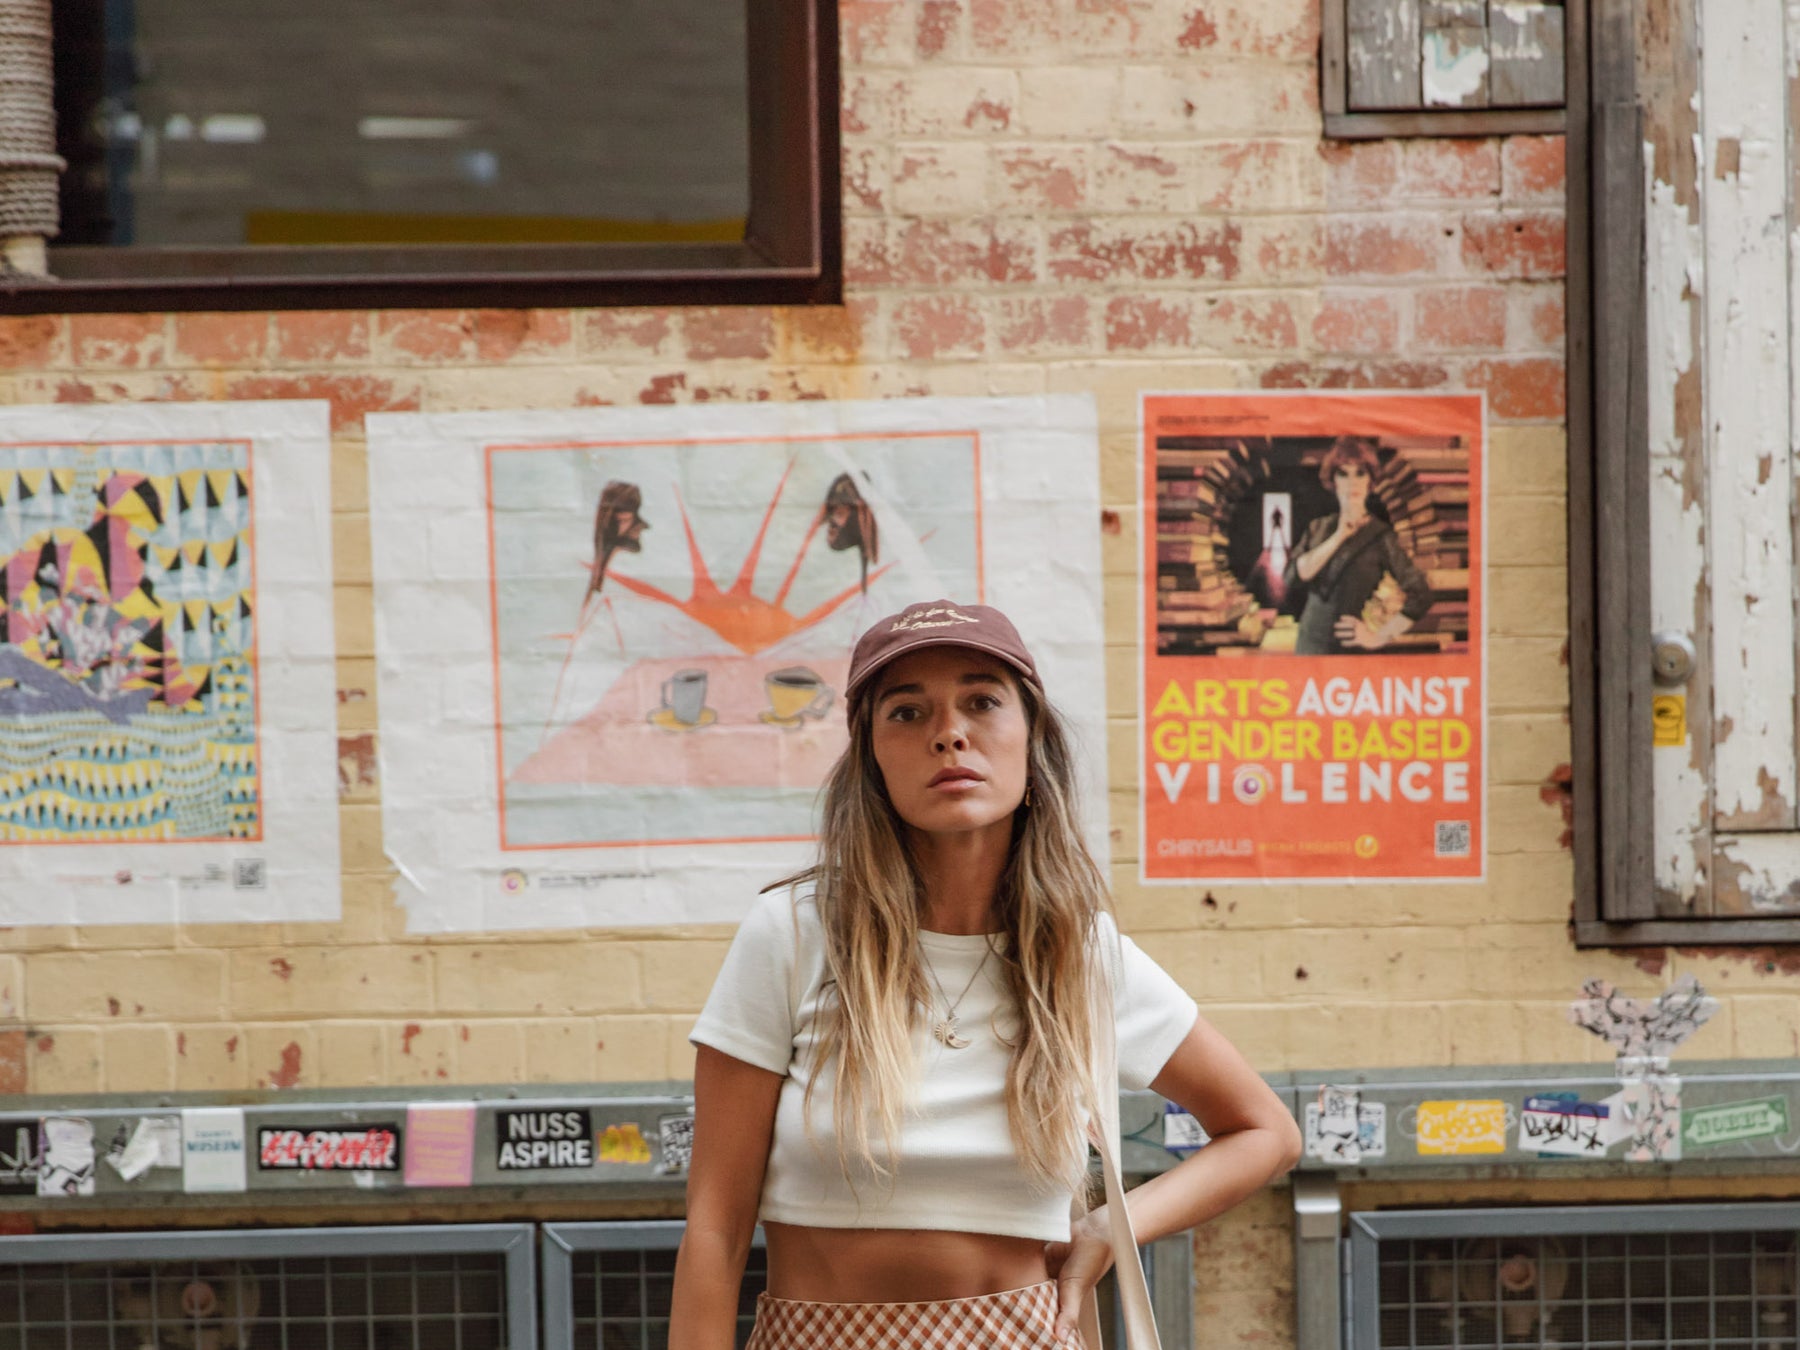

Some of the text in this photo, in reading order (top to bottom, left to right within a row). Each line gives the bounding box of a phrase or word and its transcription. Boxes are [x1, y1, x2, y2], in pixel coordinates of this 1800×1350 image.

[1152, 677, 1470, 717] ARTS AGAINST
[1152, 718, 1472, 761] GENDER BASED
[1154, 760, 1470, 804] VIOLENCE
[508, 1113, 583, 1140] NUSS
[500, 1140, 592, 1168] ASPIRE
